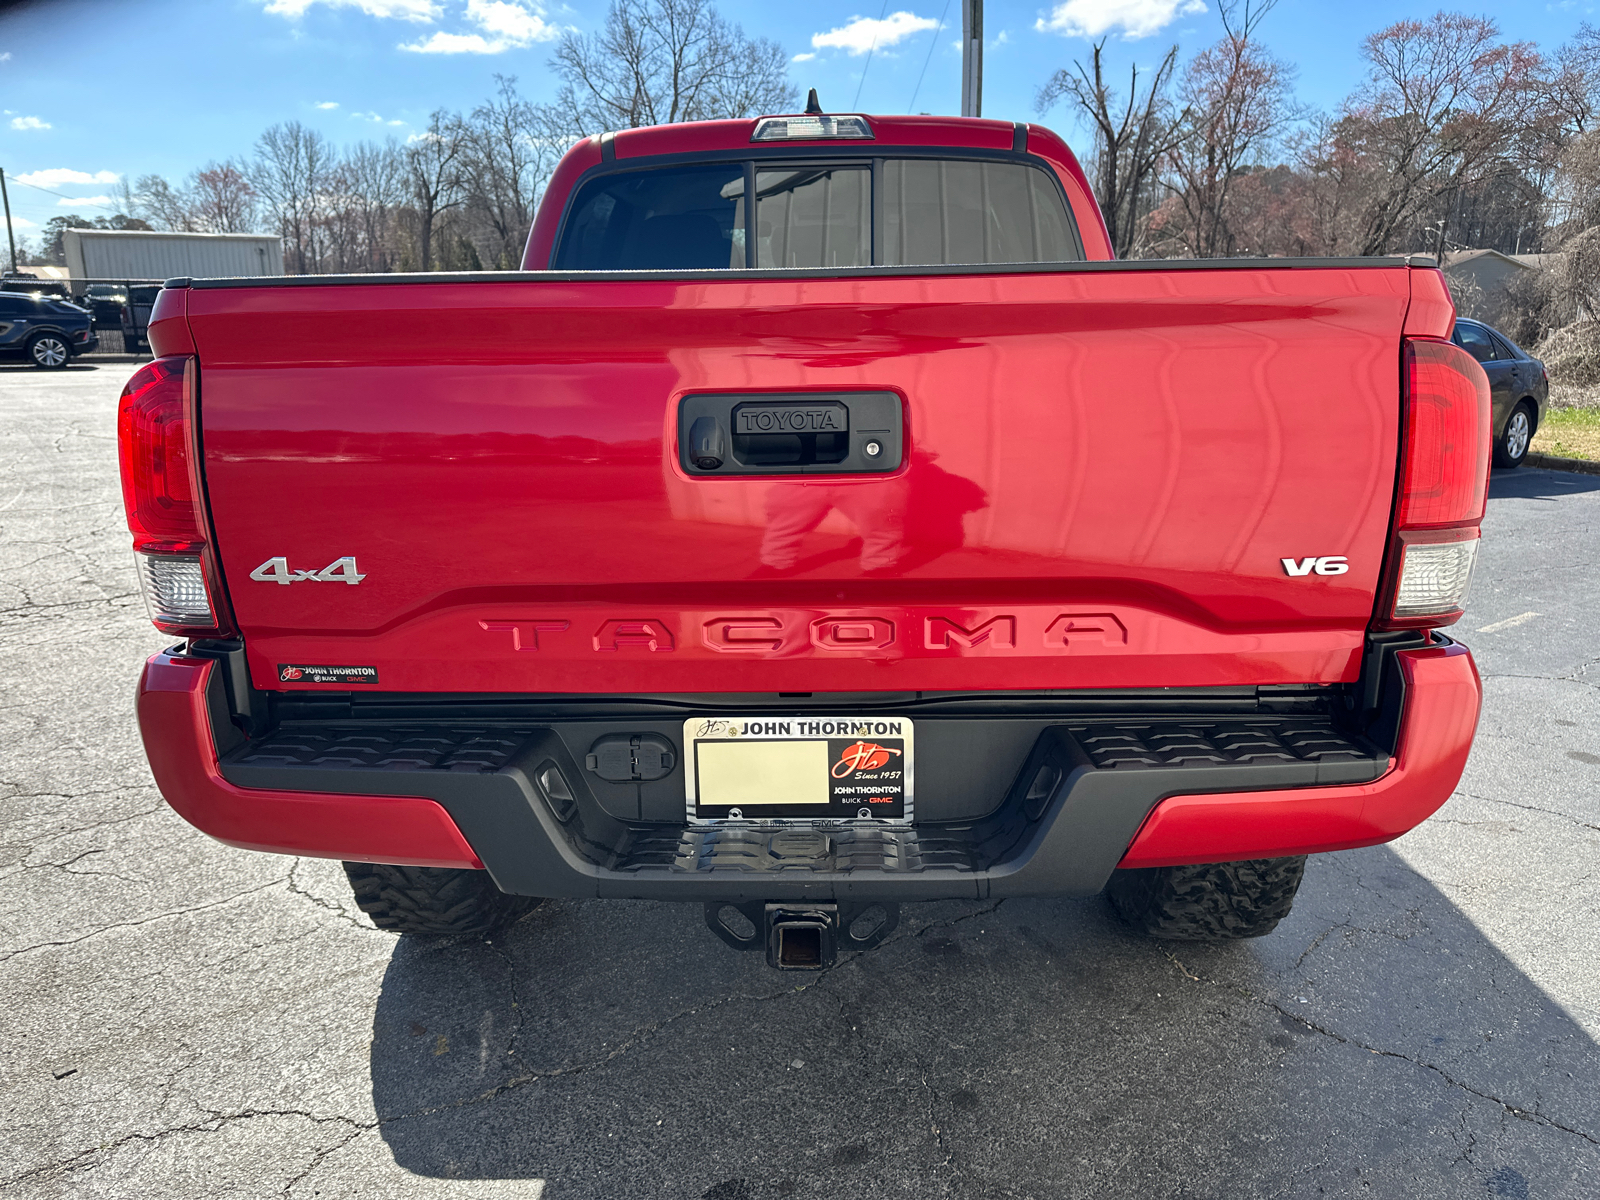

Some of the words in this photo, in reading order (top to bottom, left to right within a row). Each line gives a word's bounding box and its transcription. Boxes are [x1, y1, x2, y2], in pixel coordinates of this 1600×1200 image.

[741, 410, 839, 430] TOYOTA
[249, 556, 367, 585] 4x4
[1280, 555, 1349, 576] V6
[478, 612, 1129, 653] TACOMA
[304, 667, 327, 675] JOHN
[328, 667, 375, 676] THORNTON
[741, 722, 791, 735] JOHN
[799, 722, 902, 735] THORNTON
[854, 771, 878, 780] Since
[880, 771, 902, 779] 1957
[834, 786, 855, 794] JOHN
[856, 786, 901, 794] THORNTON
[811, 820, 841, 828] GMC
